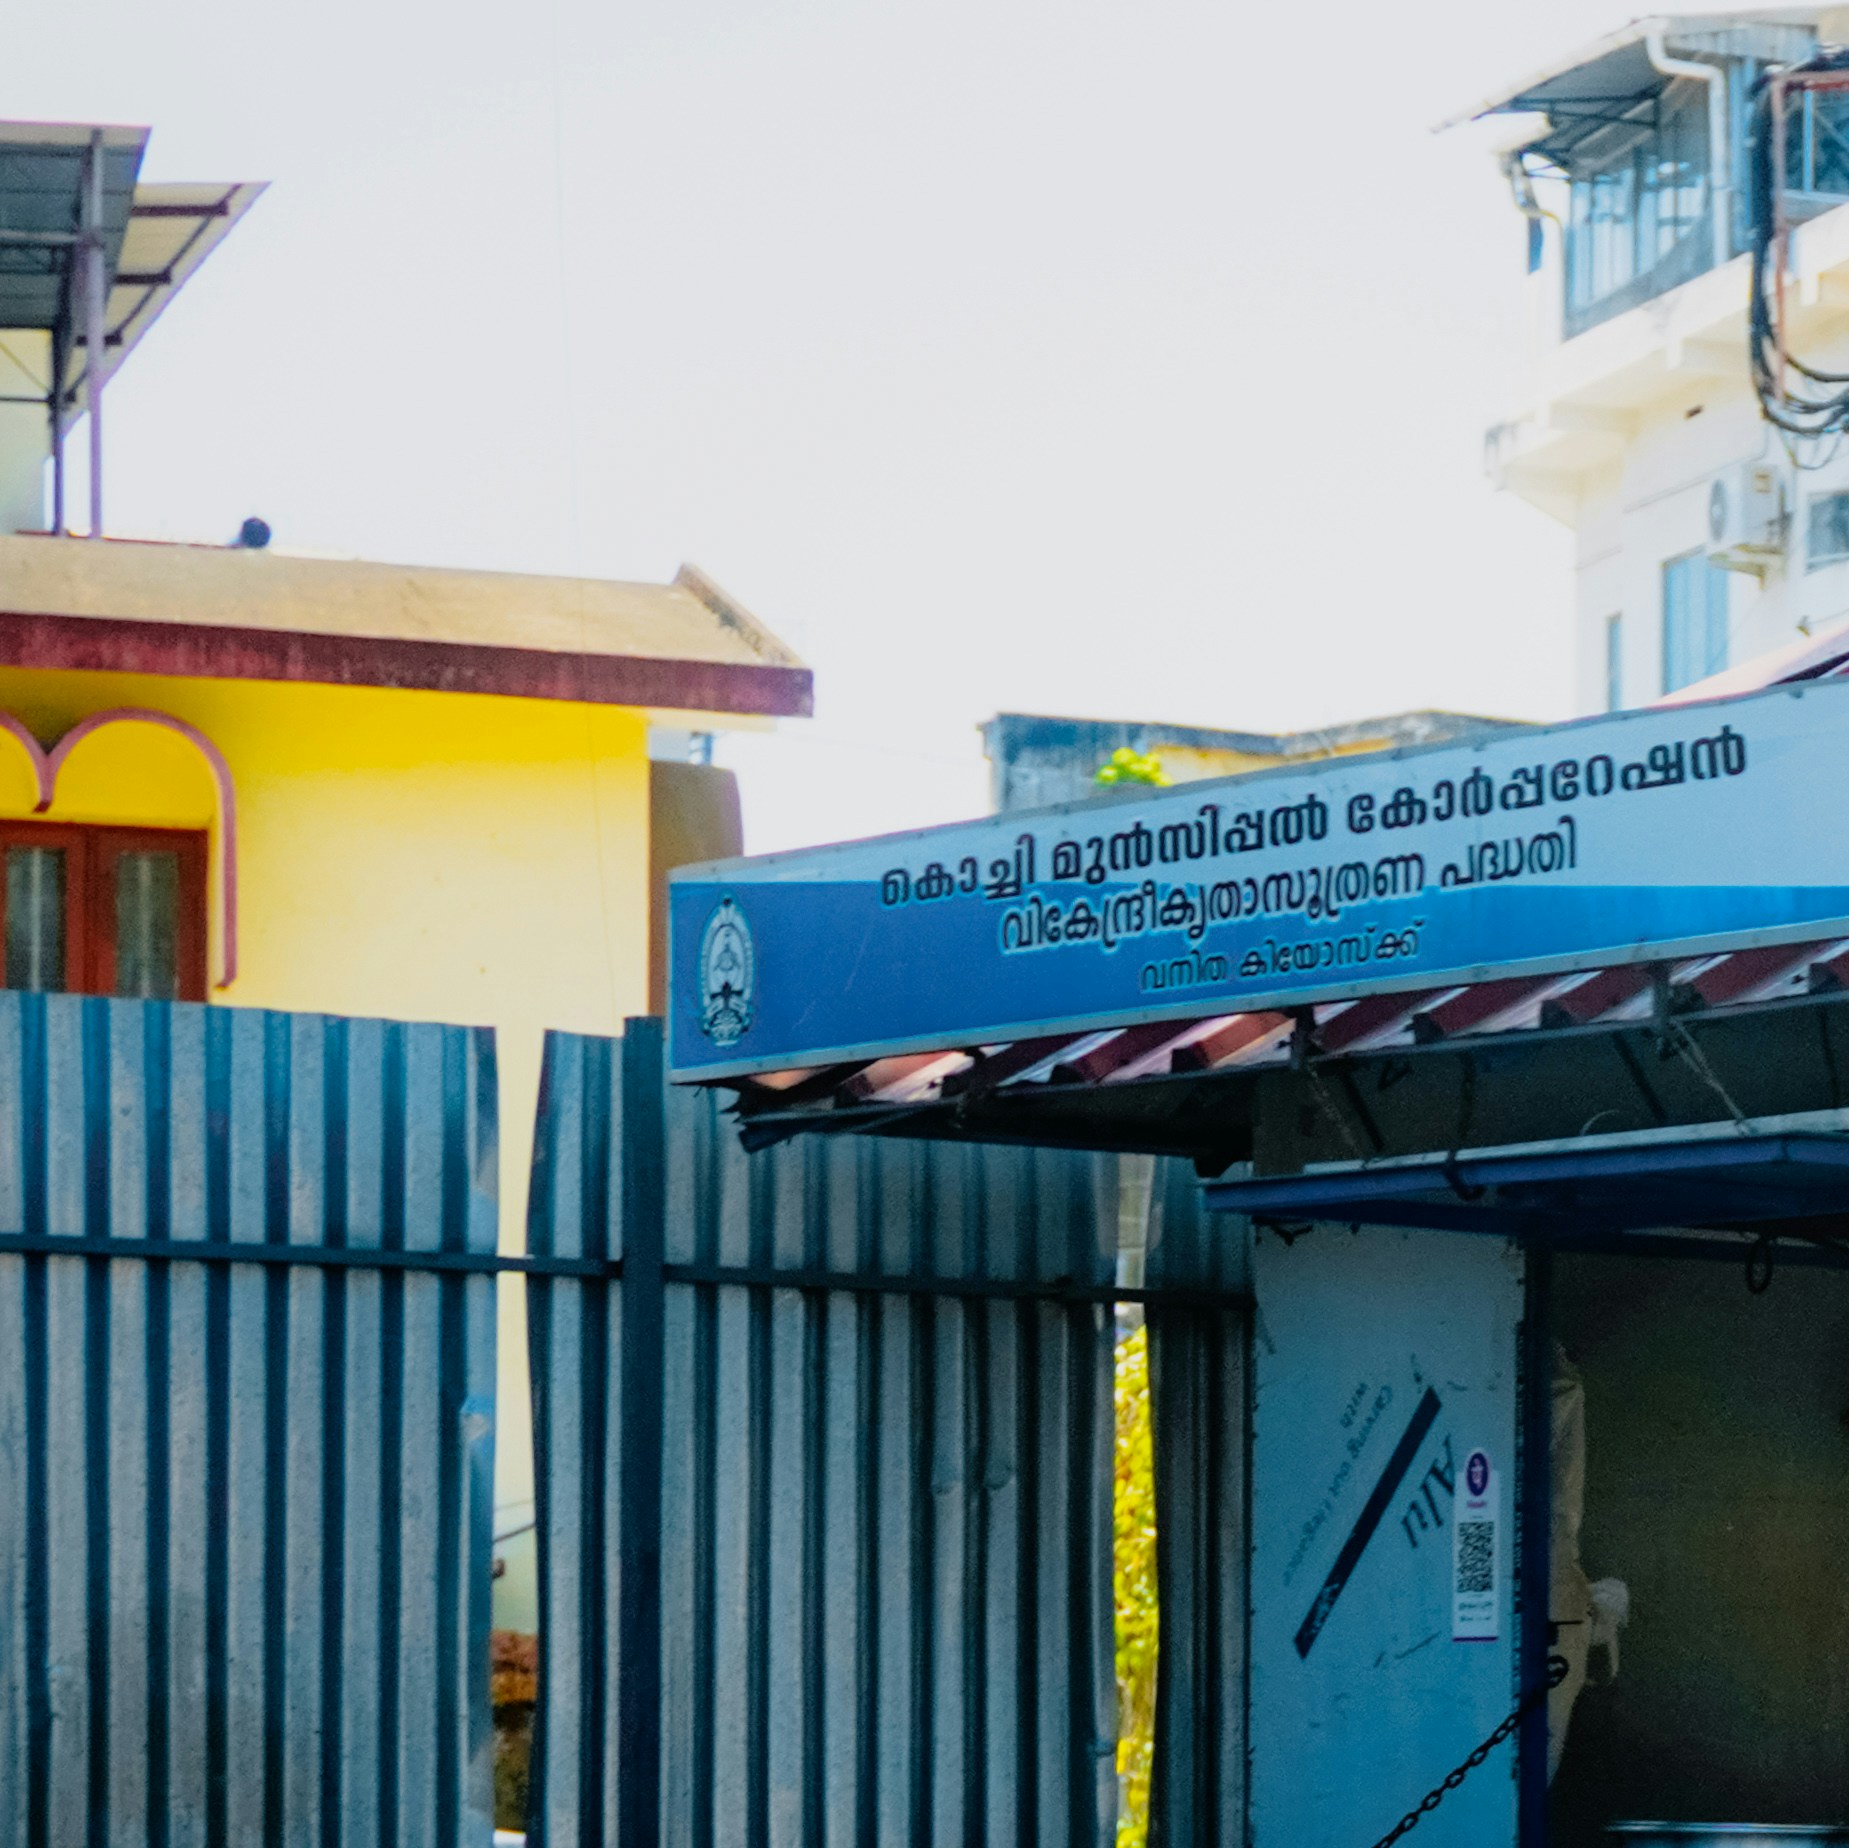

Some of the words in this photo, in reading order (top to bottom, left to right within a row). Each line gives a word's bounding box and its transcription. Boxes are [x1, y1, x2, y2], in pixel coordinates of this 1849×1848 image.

[881, 833, 1036, 905] കൊച്ചി
[1347, 723, 1747, 833] കോർപ്പറേഷൻ
[1439, 814, 1578, 887] പദ്ധതി
[1141, 948, 1228, 991] വനിത
